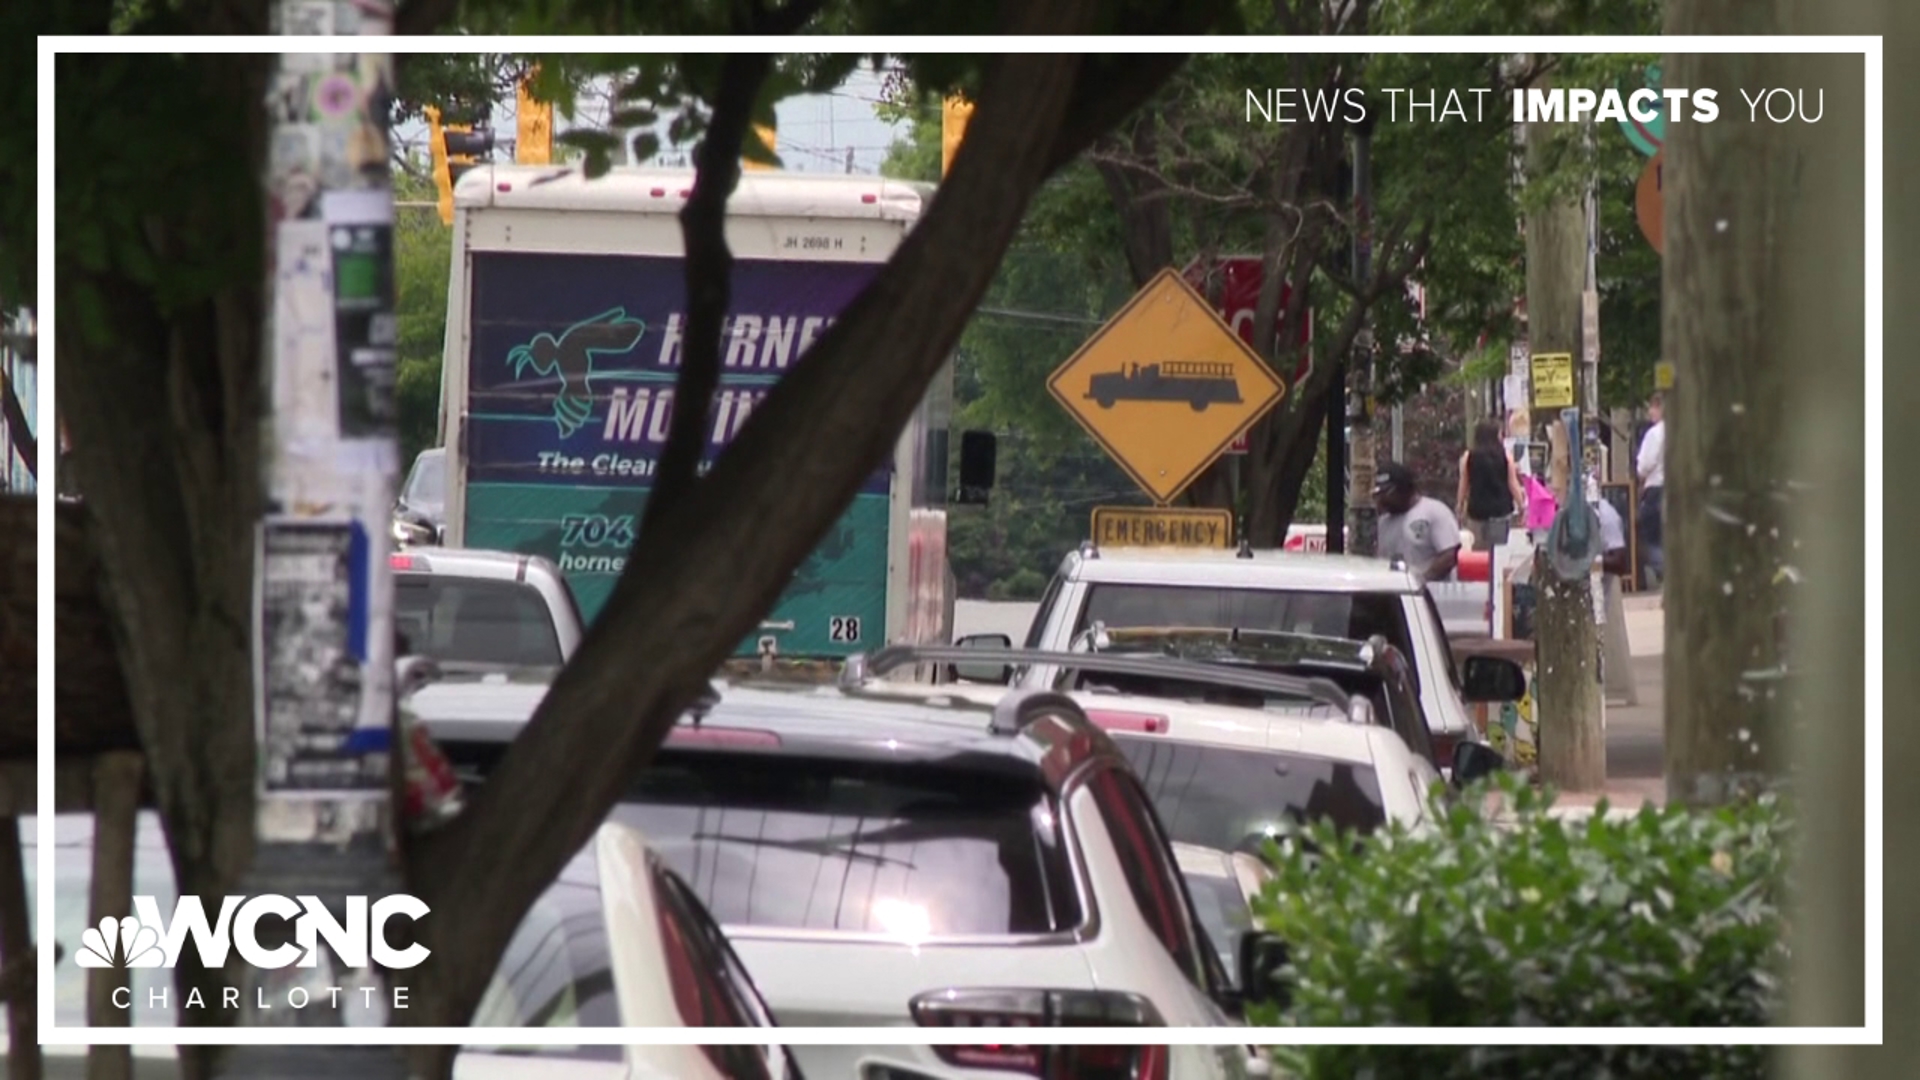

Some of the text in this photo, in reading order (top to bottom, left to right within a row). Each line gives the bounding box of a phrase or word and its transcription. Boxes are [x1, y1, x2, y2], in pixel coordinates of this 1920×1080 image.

[783, 236, 798, 249] JH
[834, 237, 843, 250] H
[537, 452, 585, 475] The
[1104, 518, 1218, 544] EMERGENCY
[832, 617, 858, 641] 28
